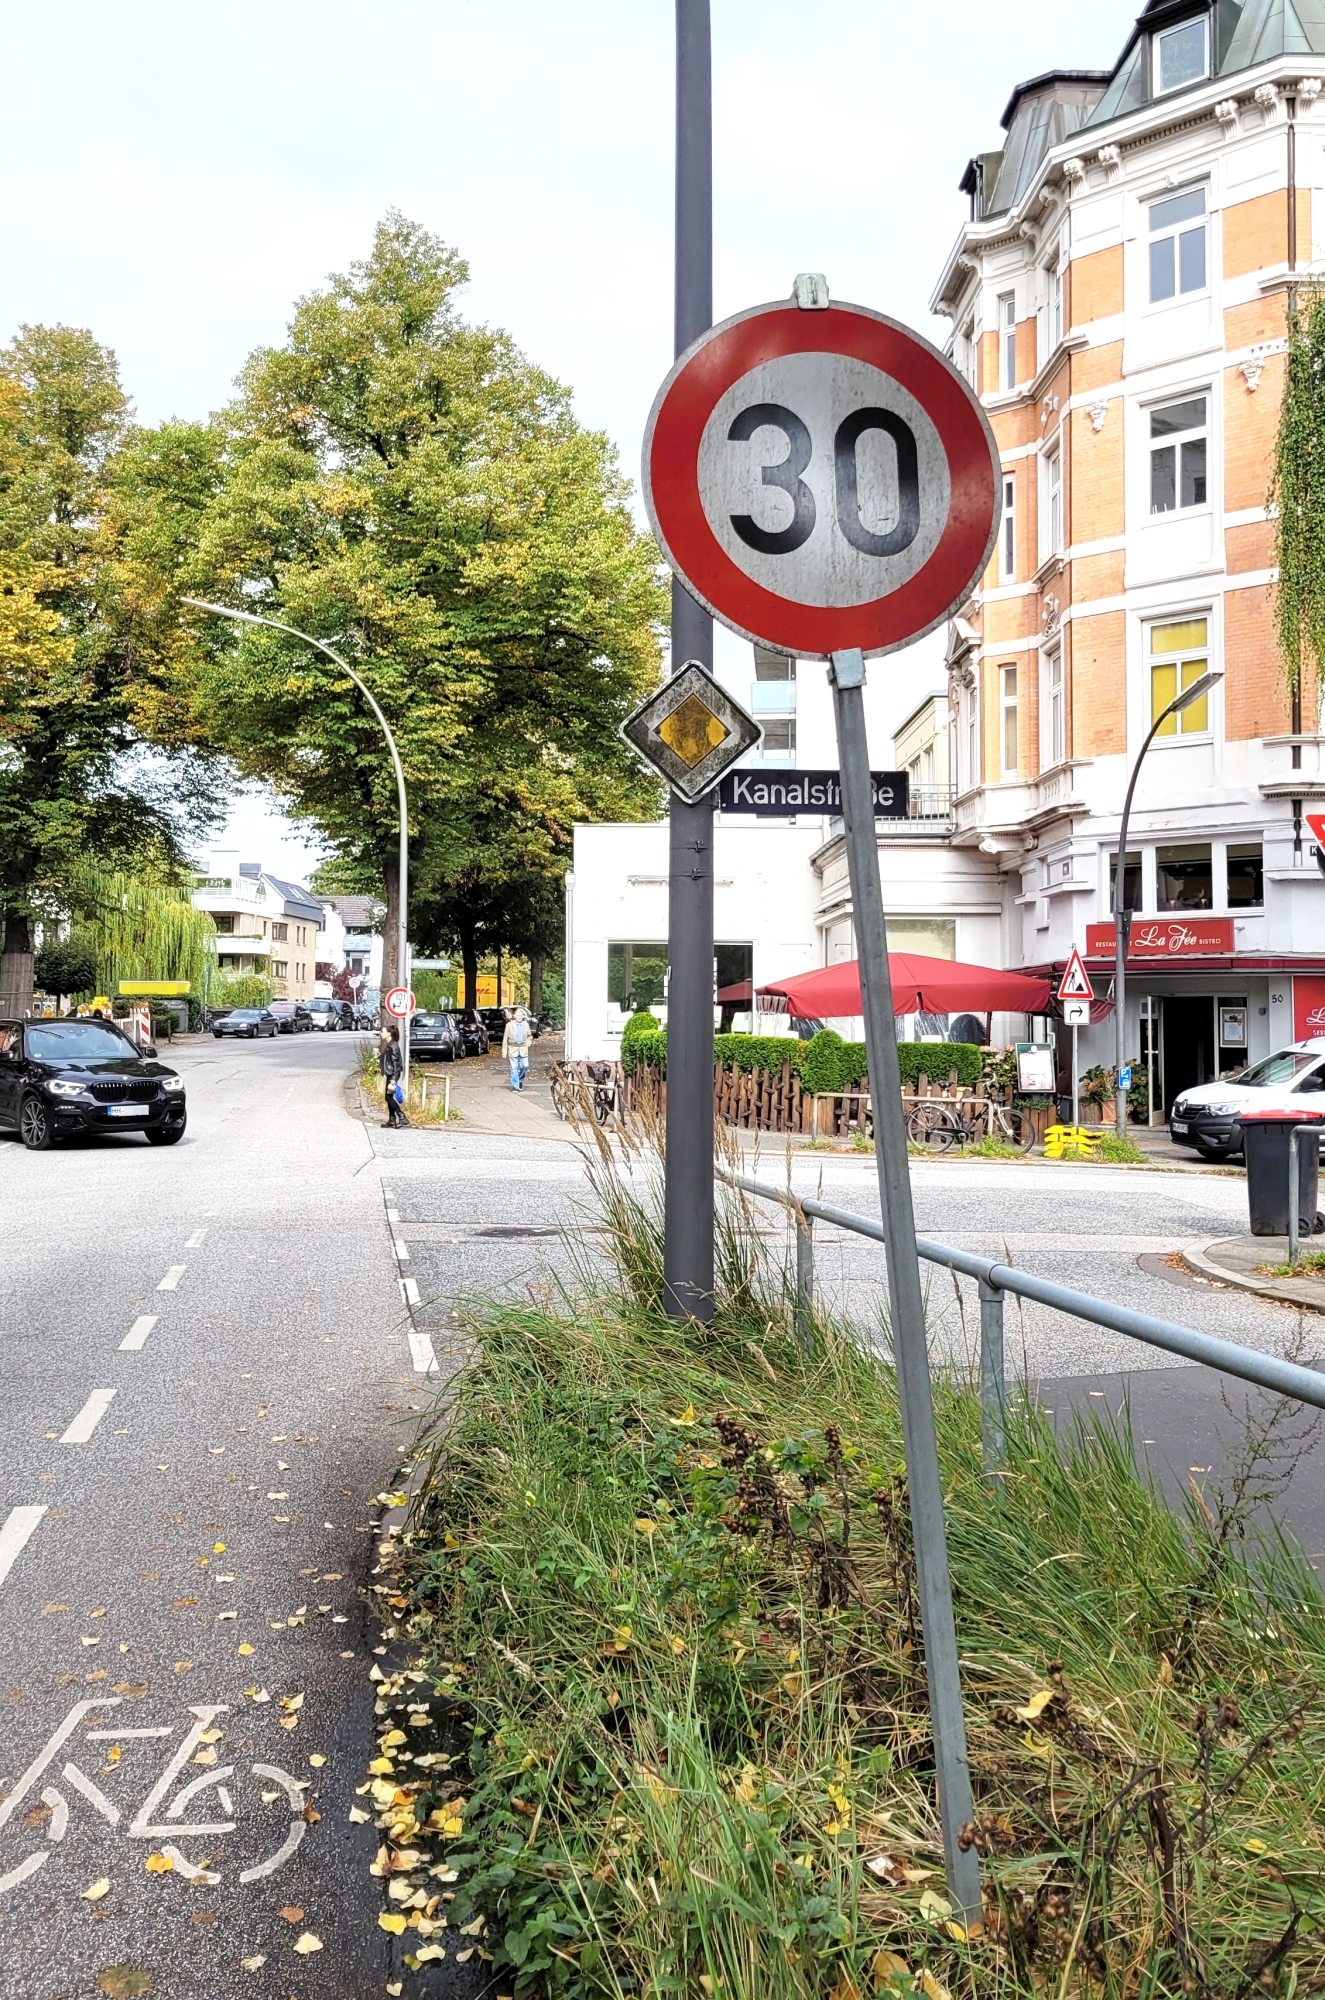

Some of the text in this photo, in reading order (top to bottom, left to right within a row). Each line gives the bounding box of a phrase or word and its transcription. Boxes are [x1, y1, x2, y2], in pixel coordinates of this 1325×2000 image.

[727, 403, 920, 557] 30
[733, 776, 894, 806] Kanalstre
[1134, 925, 1167, 947] La
[1168, 924, 1198, 952] Fée
[1271, 994, 1284, 1004] 50
